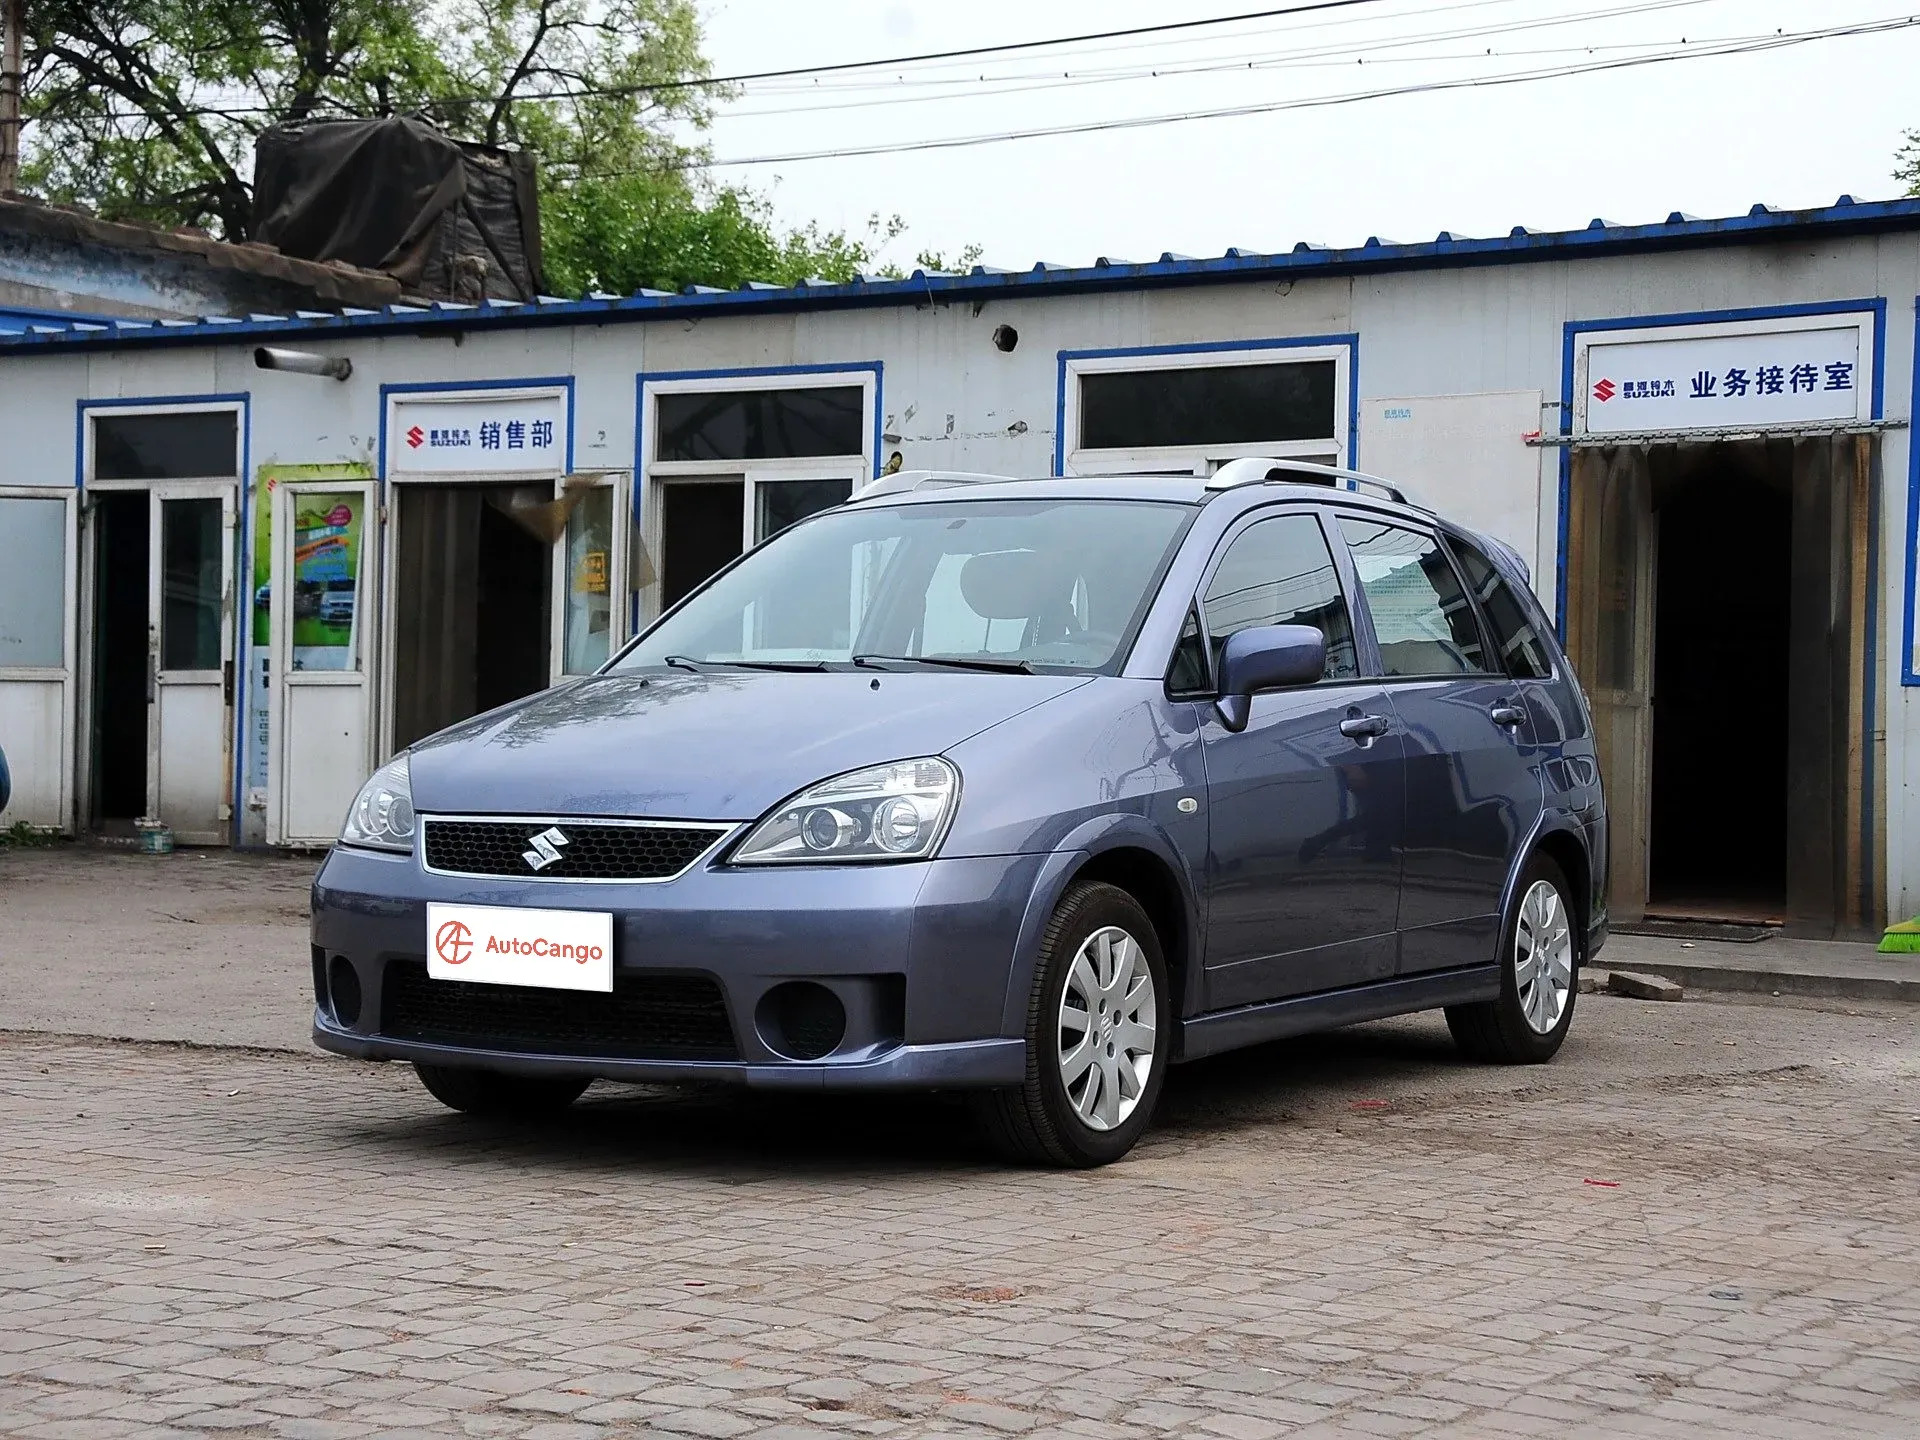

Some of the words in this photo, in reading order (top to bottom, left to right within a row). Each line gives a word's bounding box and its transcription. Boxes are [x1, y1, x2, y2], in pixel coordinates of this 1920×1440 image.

[1689, 361, 1853, 399] 业务接待室
[1623, 389, 1675, 399] SUZUKI
[430, 438, 471, 447] SUZUKI
[479, 420, 553, 450] 销售部
